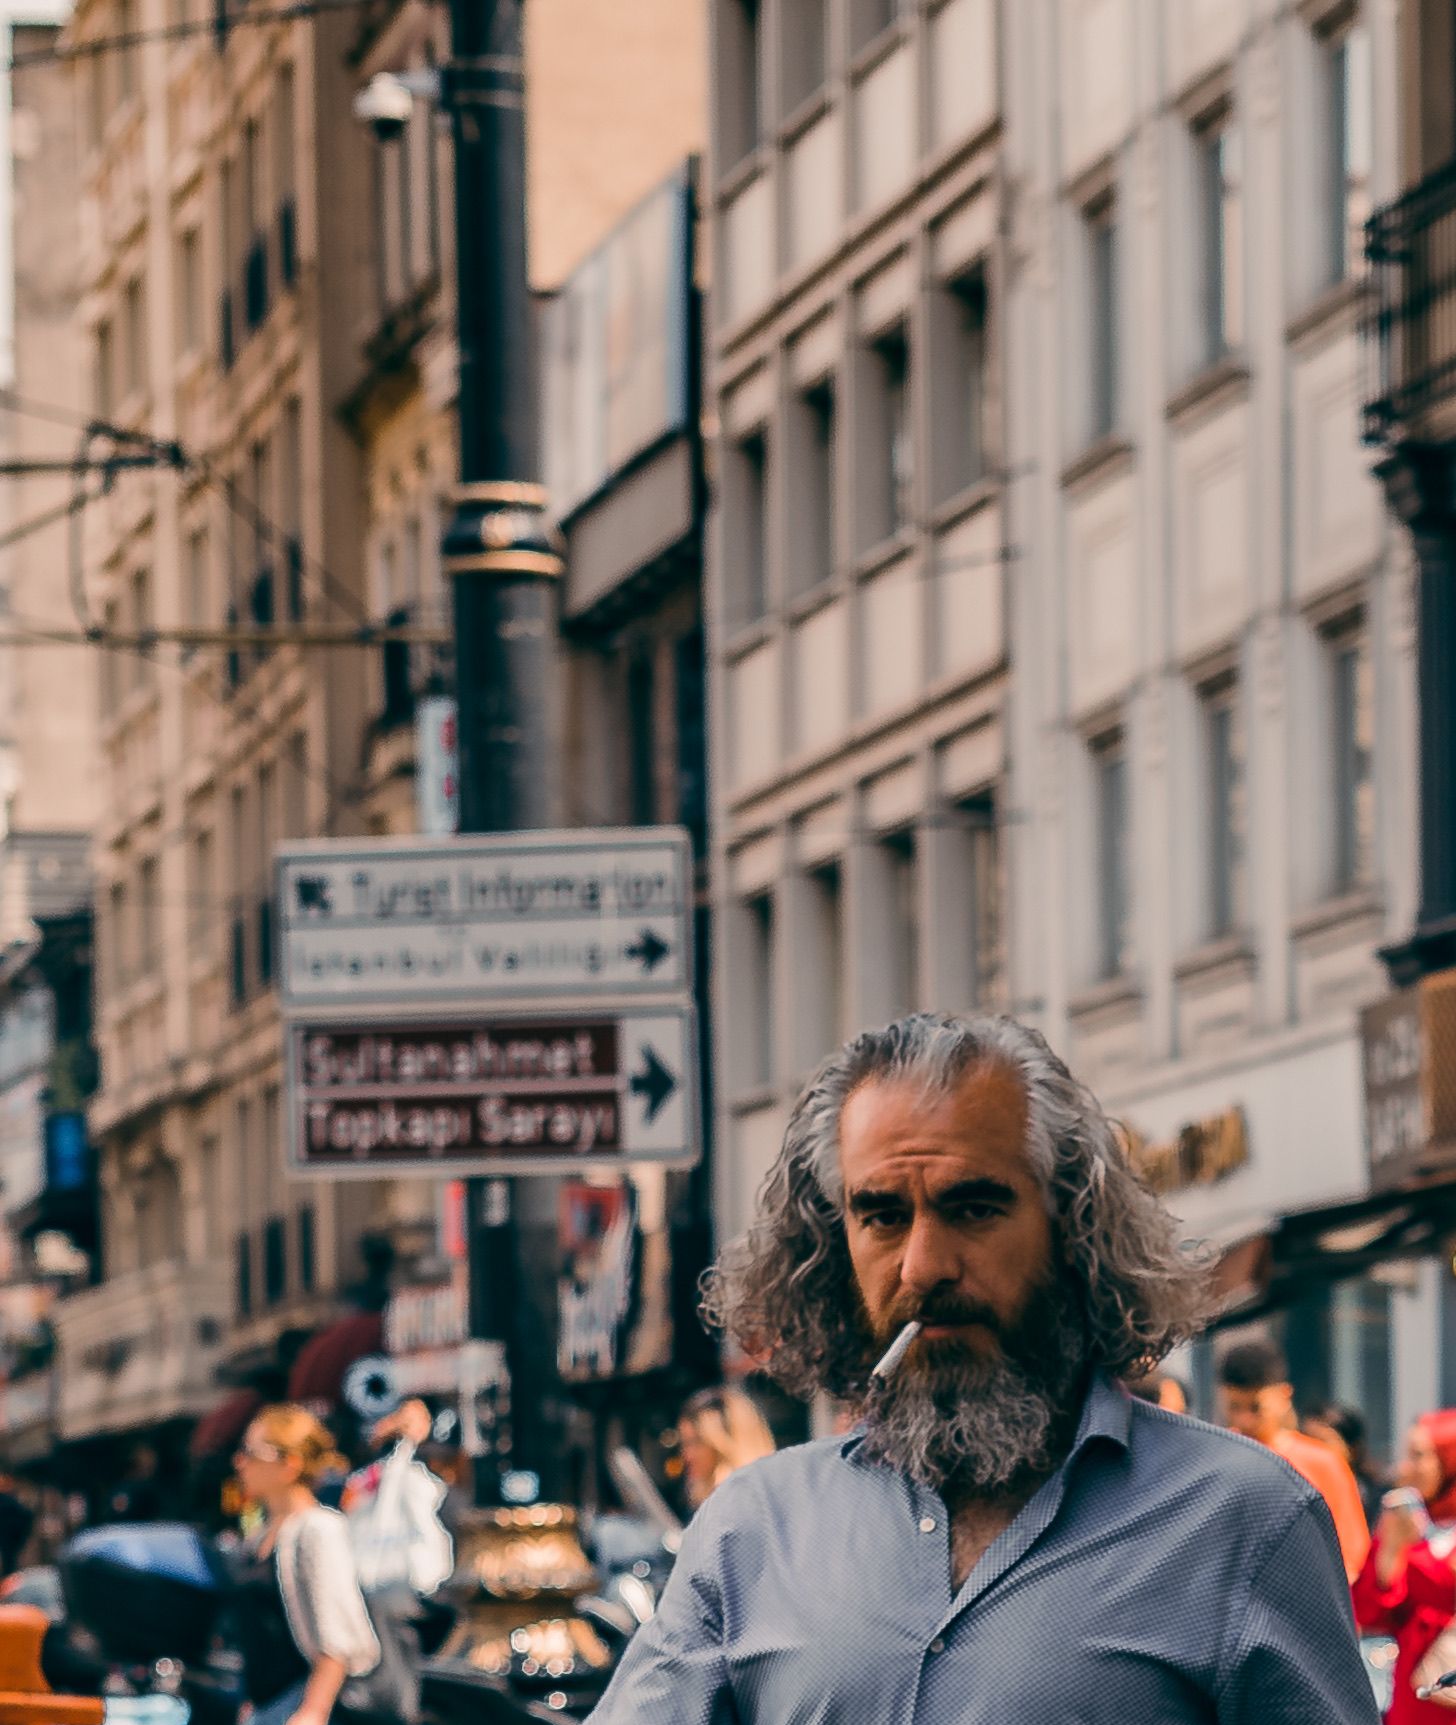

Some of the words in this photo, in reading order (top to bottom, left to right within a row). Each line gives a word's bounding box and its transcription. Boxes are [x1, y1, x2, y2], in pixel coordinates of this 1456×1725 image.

[305, 1030, 597, 1087] Sultanahmet
[304, 1096, 473, 1160] Topkapı
[478, 1094, 616, 1155] Sarayı
